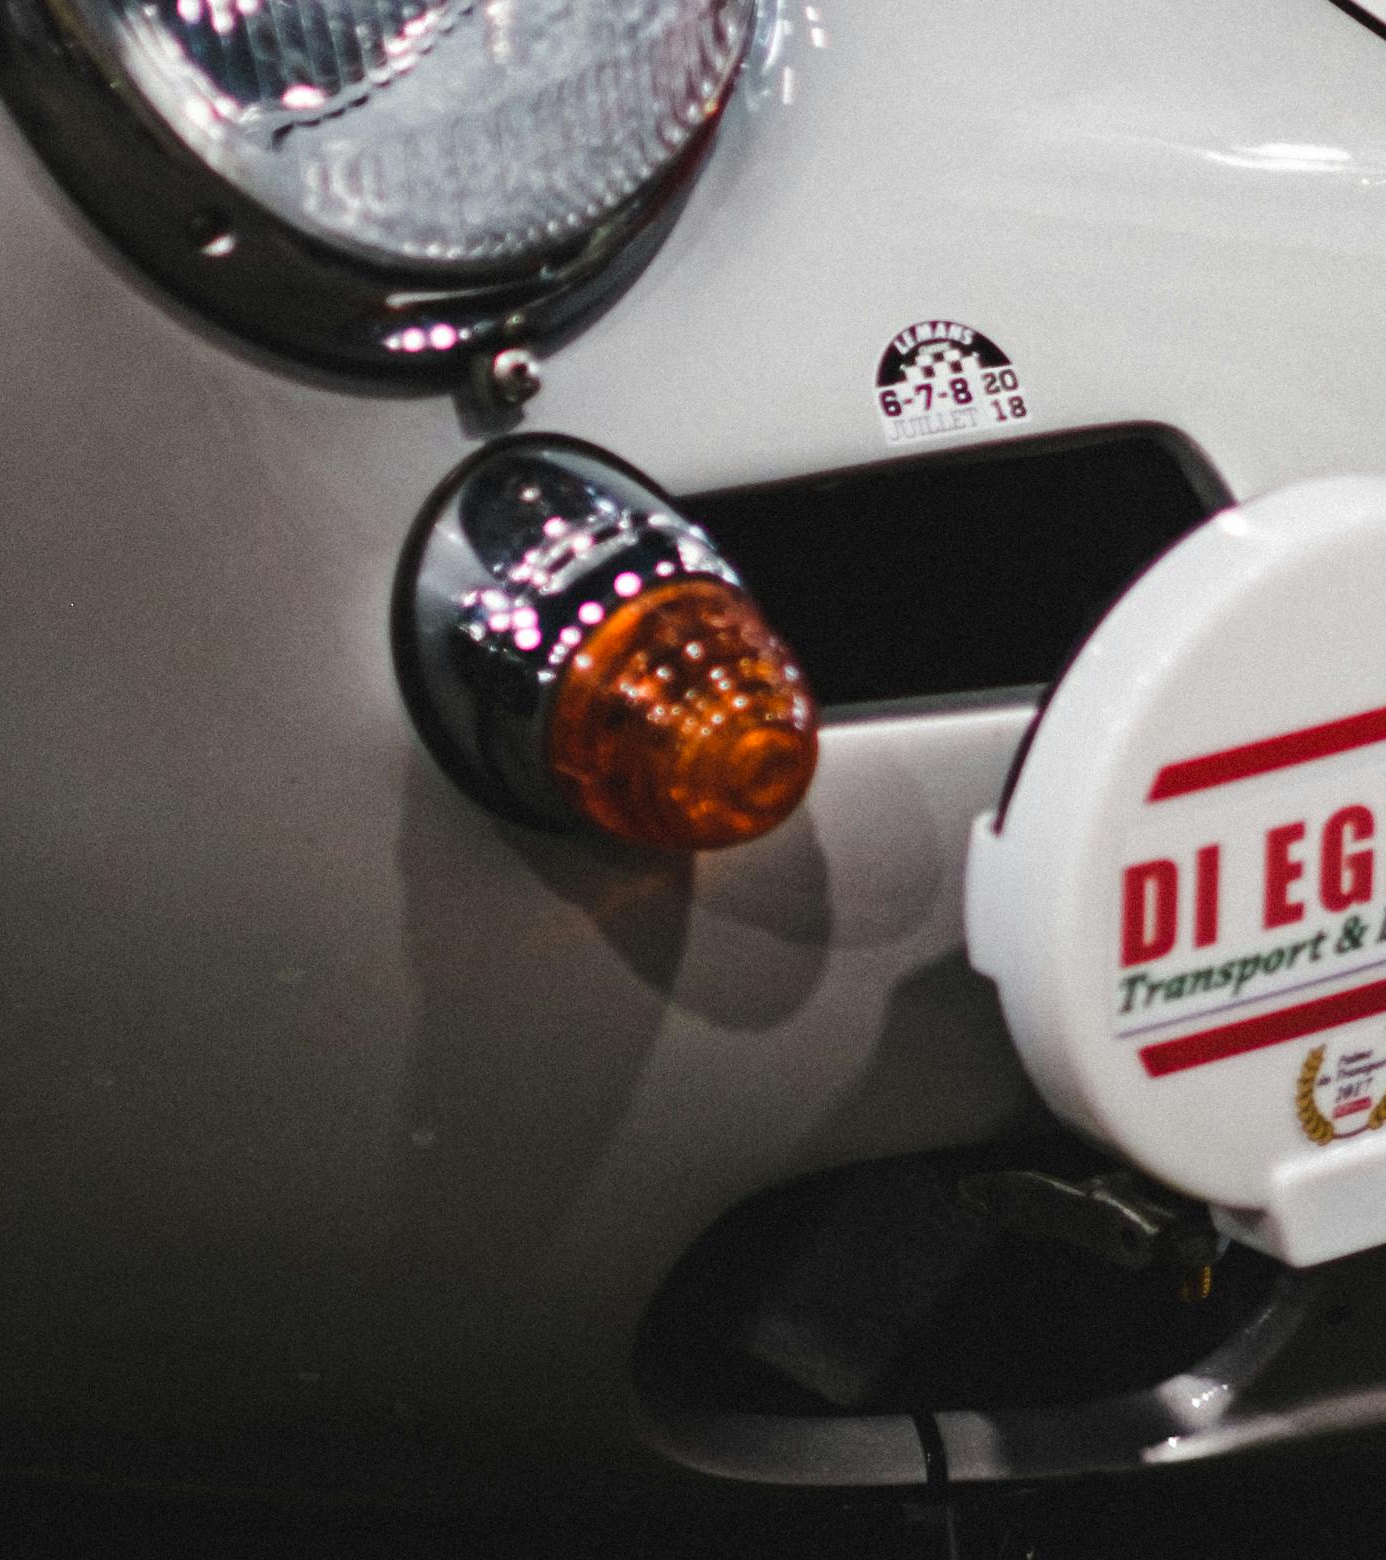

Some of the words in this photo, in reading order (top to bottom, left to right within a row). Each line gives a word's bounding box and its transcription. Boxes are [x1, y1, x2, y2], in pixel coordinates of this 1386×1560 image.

[915, 321, 974, 346] MANS
[981, 369, 1020, 395] 20
[991, 395, 1027, 422] 18
[1121, 844, 1220, 967] DI
[1120, 930, 1328, 1013] Transport
[1334, 916, 1366, 951] &
